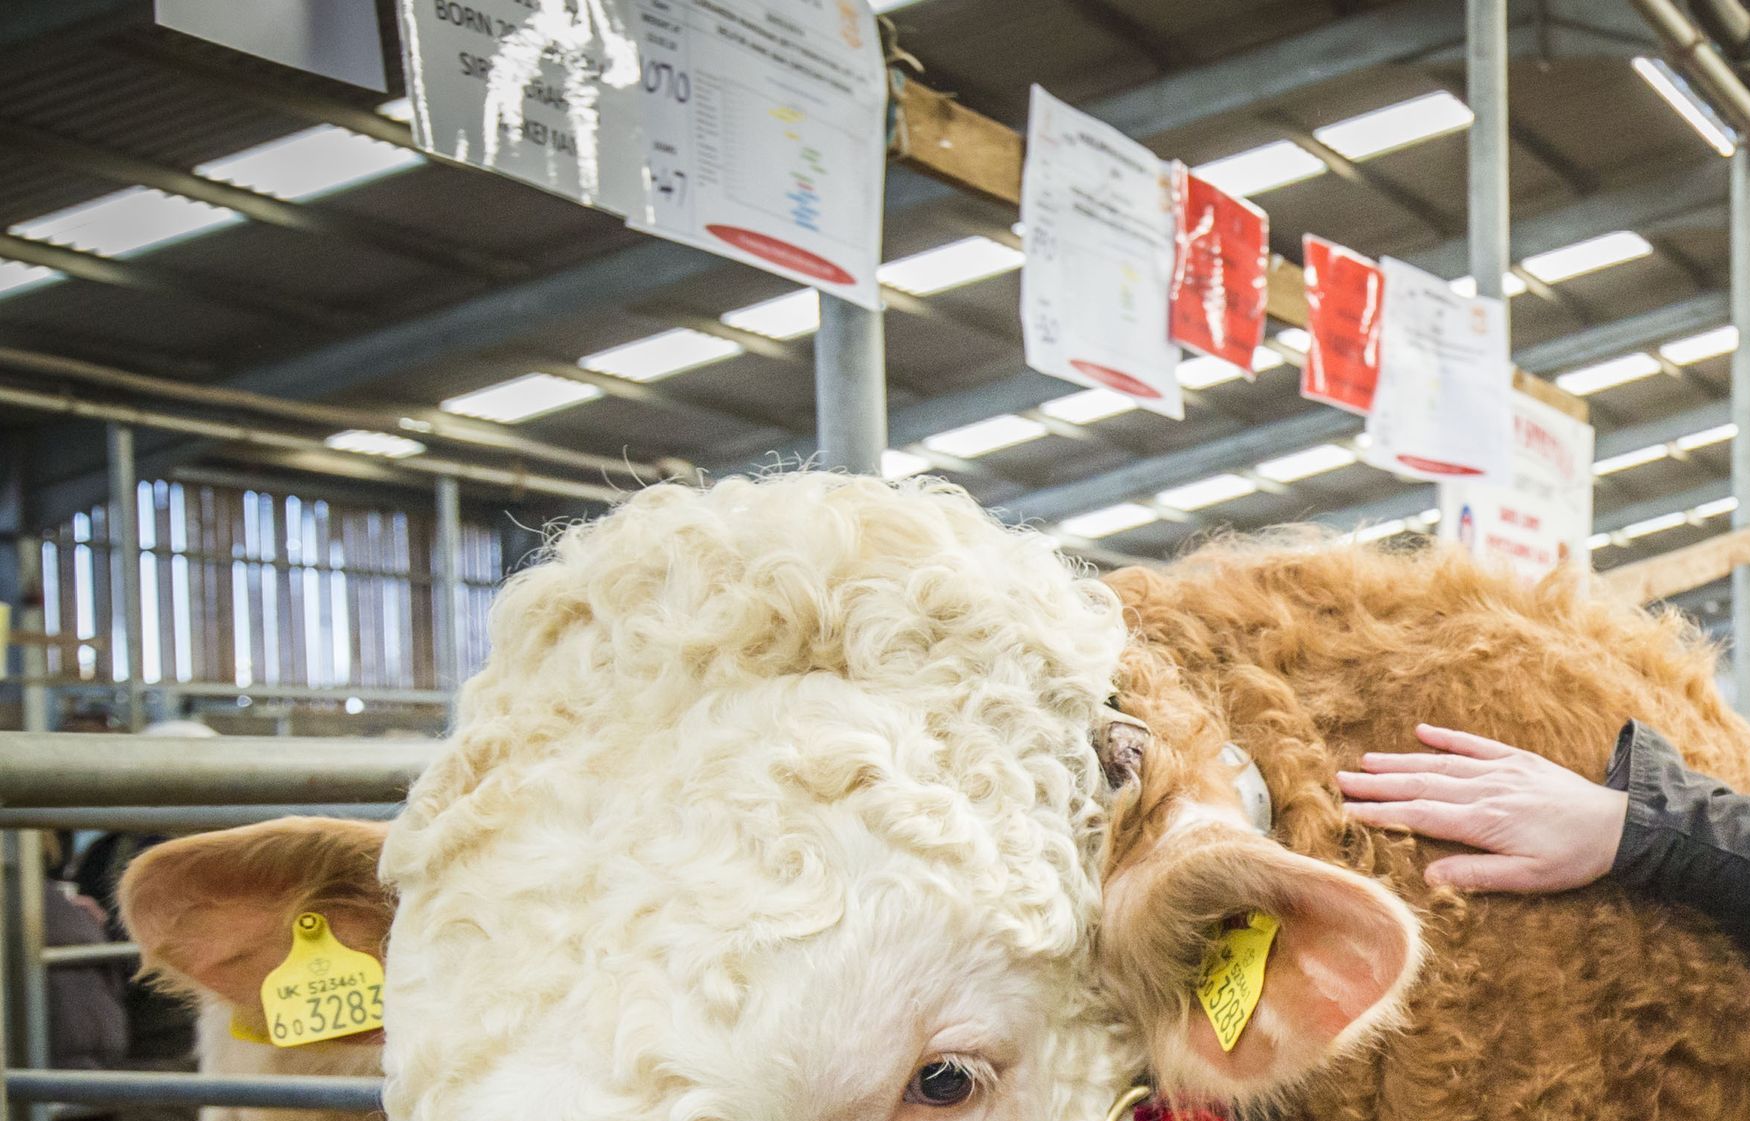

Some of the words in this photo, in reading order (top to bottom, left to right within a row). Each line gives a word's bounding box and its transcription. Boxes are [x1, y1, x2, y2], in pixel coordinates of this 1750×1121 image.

[434, 0, 493, 36] BORN
[458, 51, 493, 82] SIR
[277, 985, 301, 1000] UK
